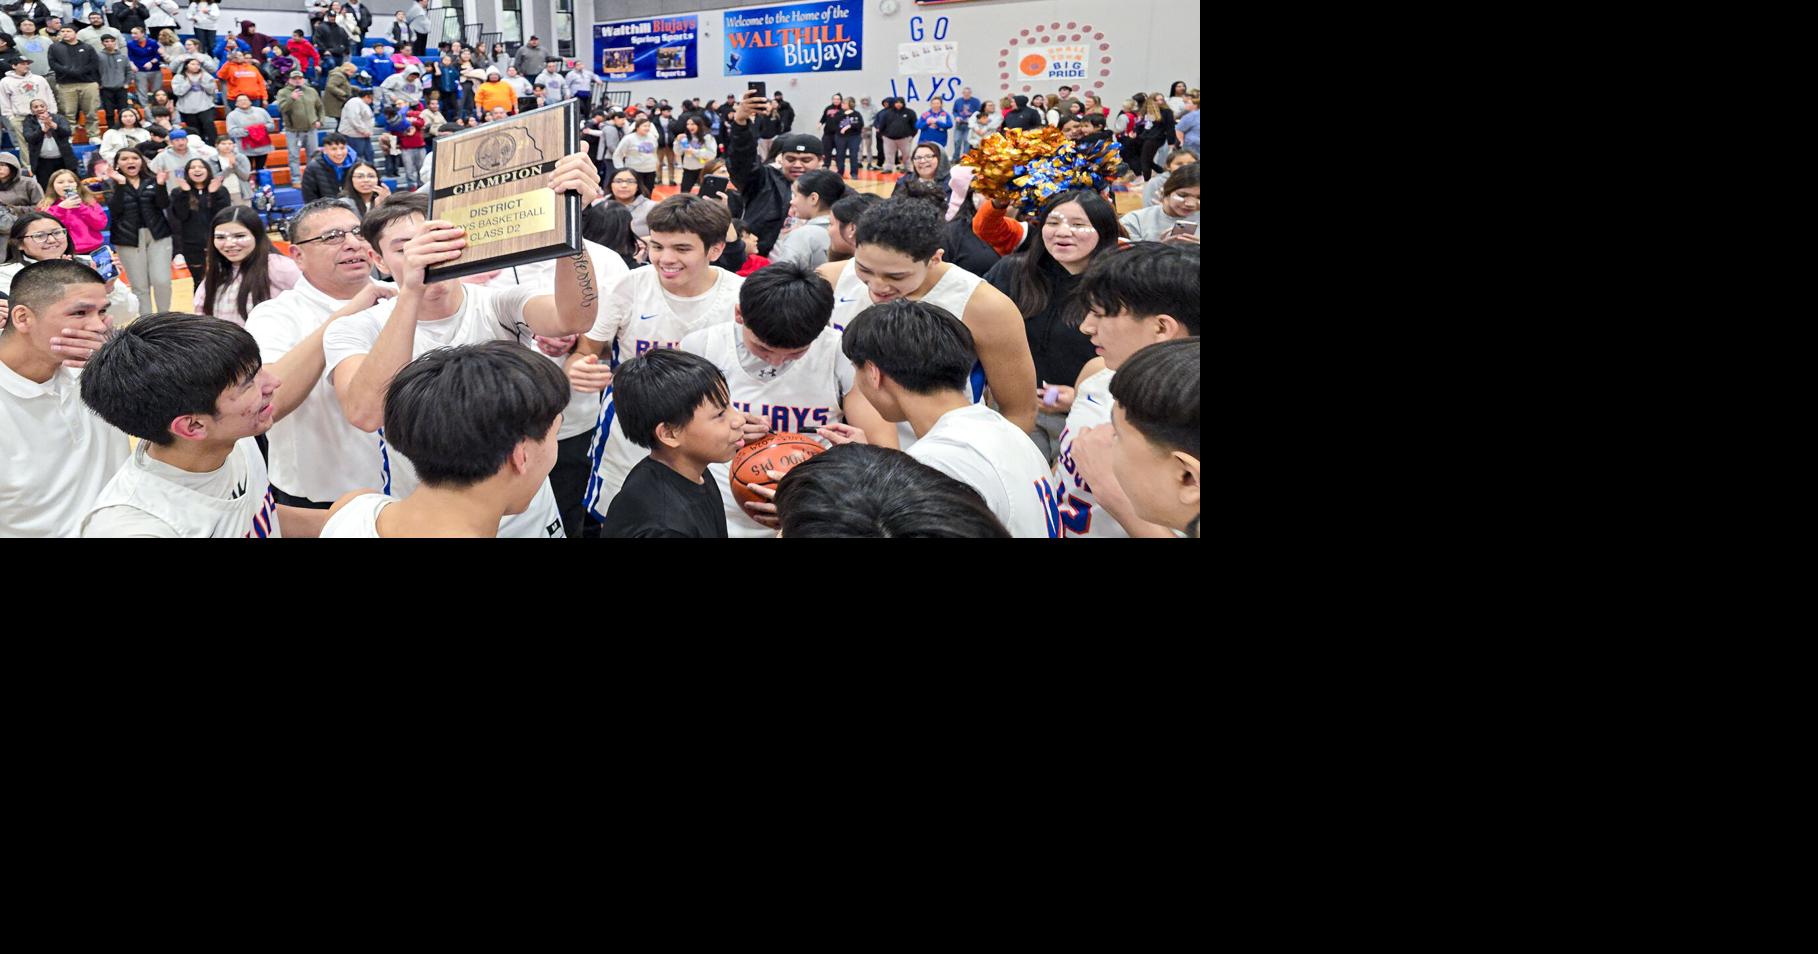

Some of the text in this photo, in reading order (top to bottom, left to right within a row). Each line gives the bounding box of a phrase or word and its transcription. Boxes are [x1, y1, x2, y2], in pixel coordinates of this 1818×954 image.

[726, 5, 850, 27] Welcome to the Home of the
[601, 22, 652, 37] Walthill
[630, 32, 695, 45] Spring Sports
[727, 23, 851, 49] WALTHILL
[910, 16, 949, 42] GO
[782, 38, 858, 71] BluJays
[1048, 69, 1085, 78] PRIDE
[1052, 61, 1082, 70] BIG
[453, 164, 544, 196] CHAMPION
[469, 198, 523, 219] DISTRICT
[478, 206, 545, 229] BASKETBALL
[469, 224, 521, 242] CLASS D2
